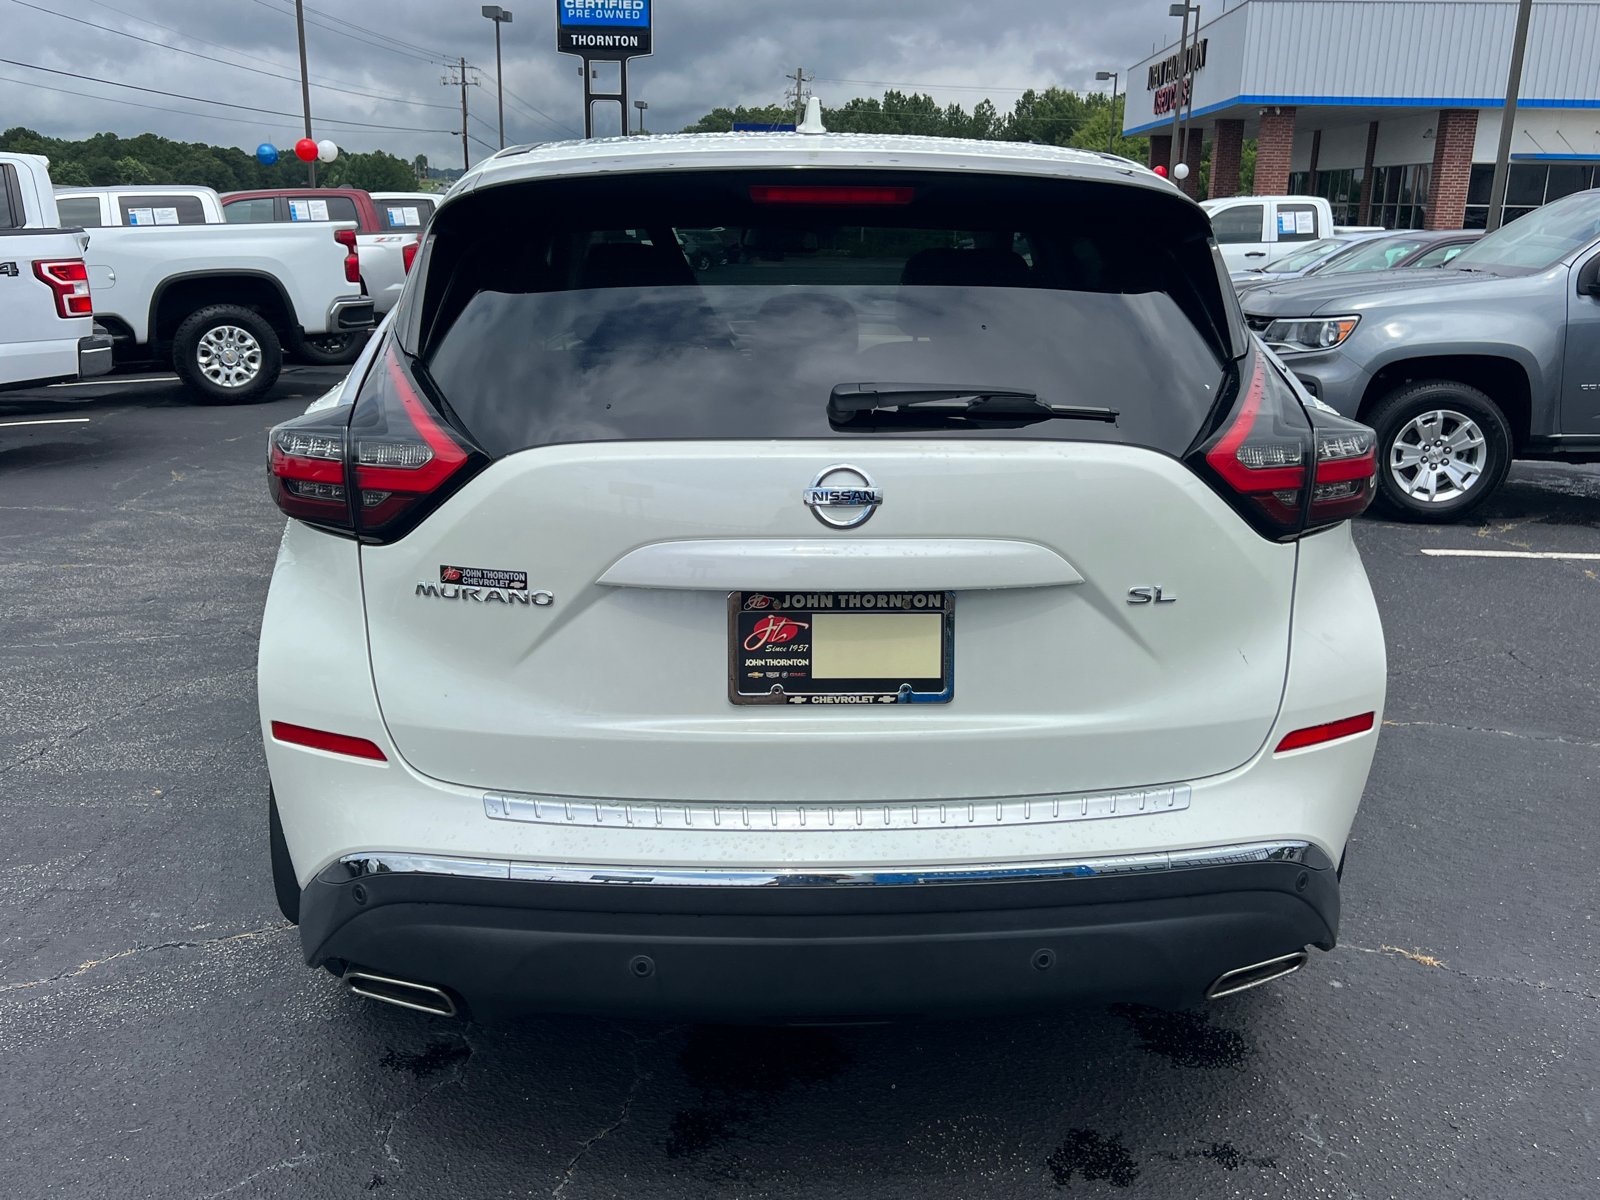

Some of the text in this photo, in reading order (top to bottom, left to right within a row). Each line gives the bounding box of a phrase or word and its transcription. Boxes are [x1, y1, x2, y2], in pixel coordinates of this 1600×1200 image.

[564, 0, 644, 9] CERTIFIED
[568, 9, 640, 19] PRE-OWNED
[571, 35, 638, 46] THORNTON
[812, 491, 875, 501] NISSAN
[462, 569, 525, 581] JOHN THORNTON
[462, 577, 509, 588] CHEVROLET
[415, 581, 554, 606] MURANO
[1127, 586, 1177, 604] SL
[782, 594, 833, 608] JOHN
[838, 594, 941, 608] THORNTON
[765, 644, 809, 652] Since 1957
[766, 658, 809, 667] THORNTON
[811, 696, 875, 704] CHEVROLET
